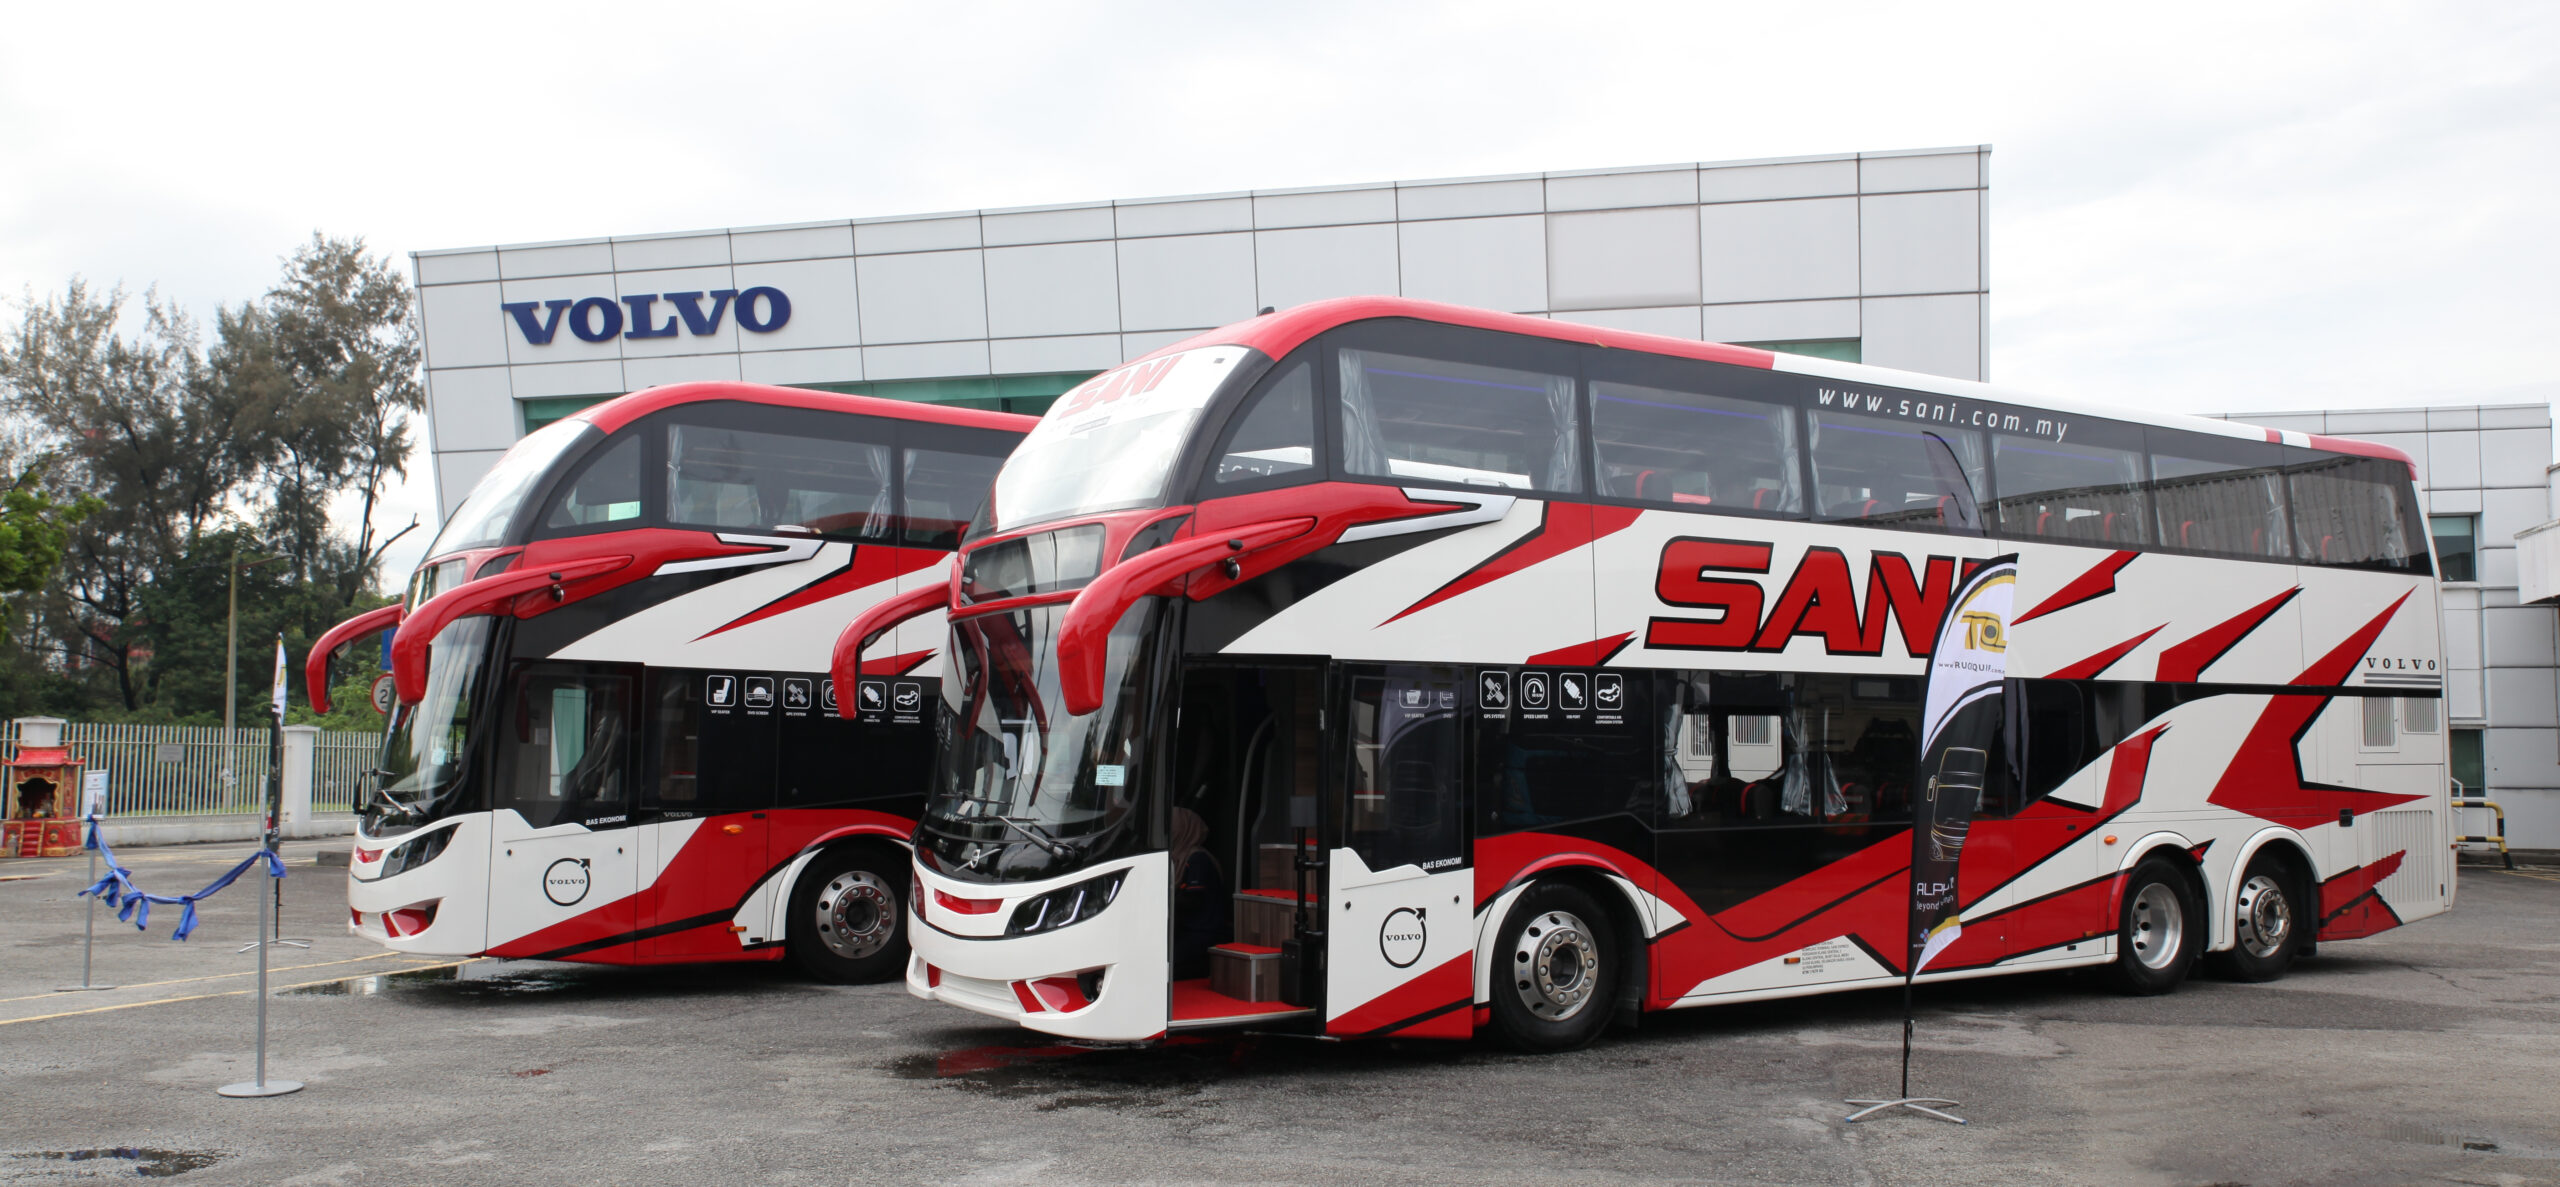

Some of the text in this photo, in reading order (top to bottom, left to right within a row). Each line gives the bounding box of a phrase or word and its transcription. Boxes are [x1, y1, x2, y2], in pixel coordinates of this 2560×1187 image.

[501, 286, 791, 345] VOLVO
[1056, 353, 1185, 421] SANI
[1819, 388, 2068, 443] www.sani.com.my
[2366, 657, 2436, 671] VOLVO
[586, 815, 627, 826] BAS EKONOMI
[1422, 857, 1462, 870] BAS EKONOMI
